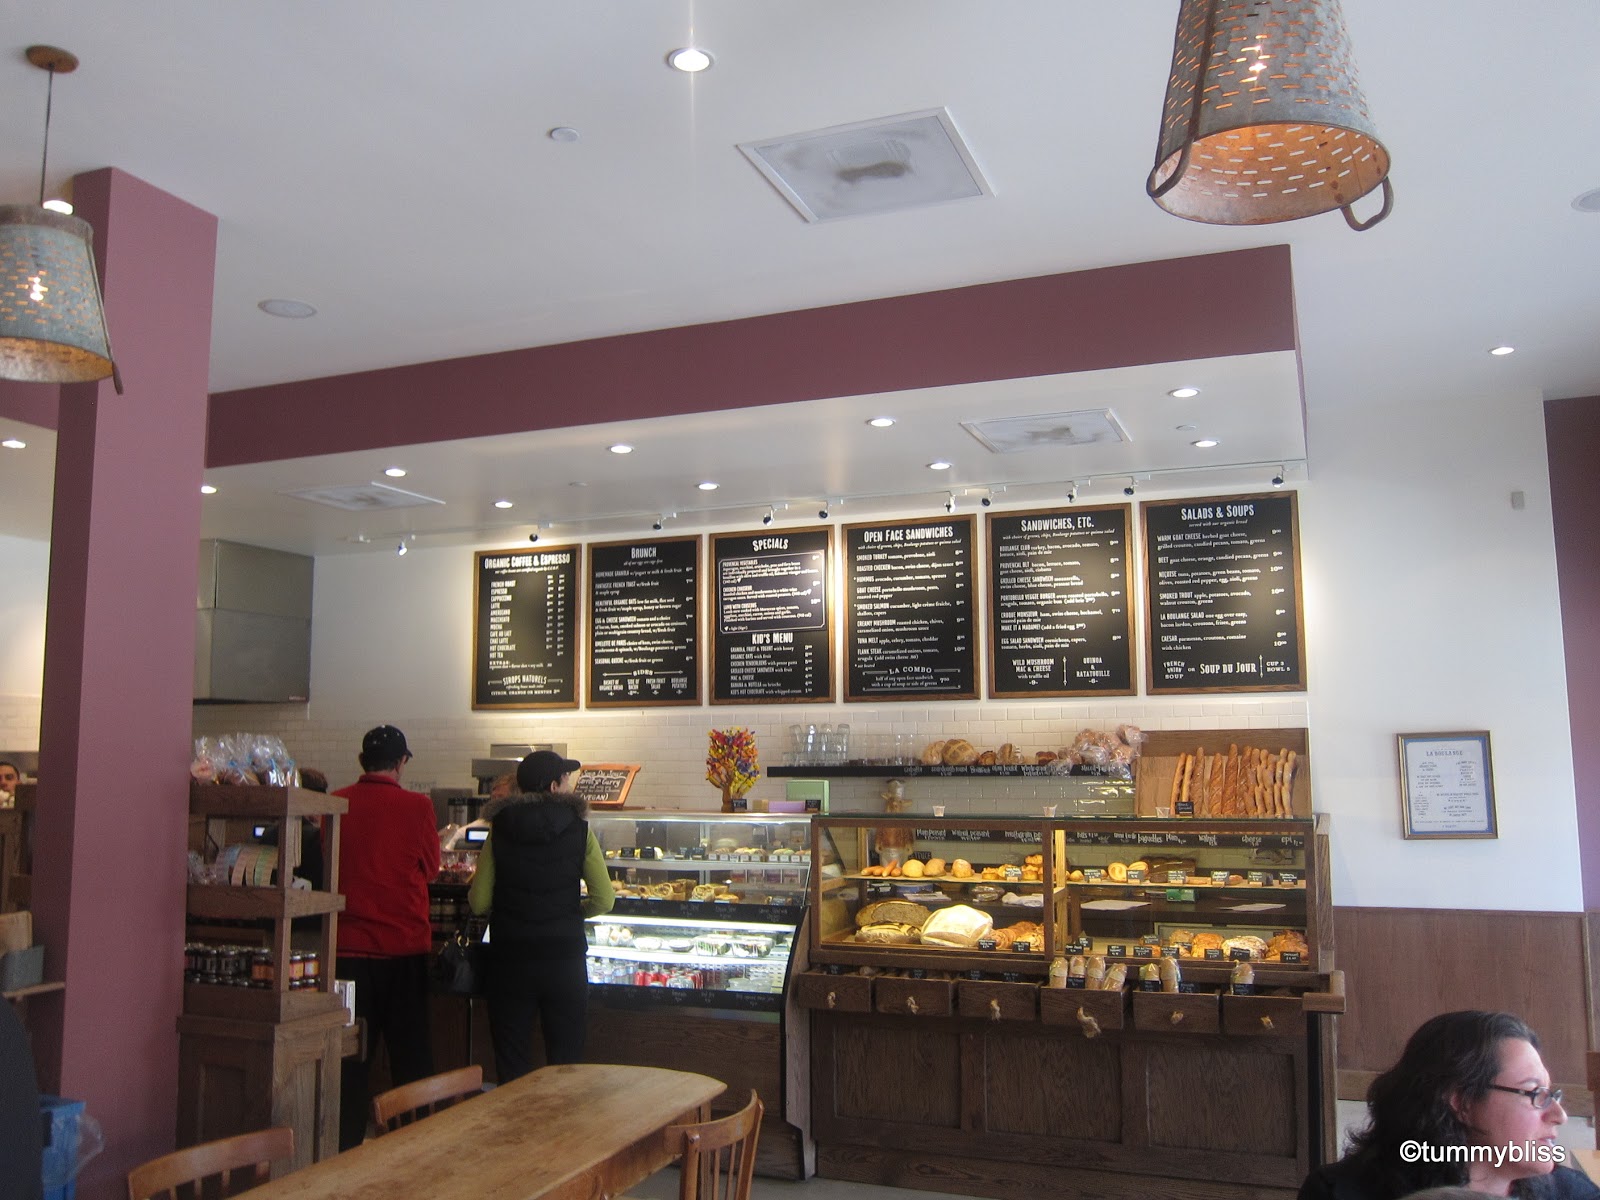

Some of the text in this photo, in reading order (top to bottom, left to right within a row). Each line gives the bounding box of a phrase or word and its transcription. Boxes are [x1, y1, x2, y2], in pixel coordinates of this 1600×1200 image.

[1181, 505, 1254, 520] SALADS & SOUPS
[1021, 517, 1094, 532] SANDWICHES, ETC.
[864, 526, 953, 542] OPEN FACE SANDWICHES
[752, 538, 789, 551] SPECIALS
[631, 547, 656, 559] BRUNCH
[485, 554, 570, 569] ORGANIC COFFEE & ESPRESSO
[752, 632, 793, 644] KID'S MENU
[1200, 662, 1257, 674] SOUP DU JOUR
